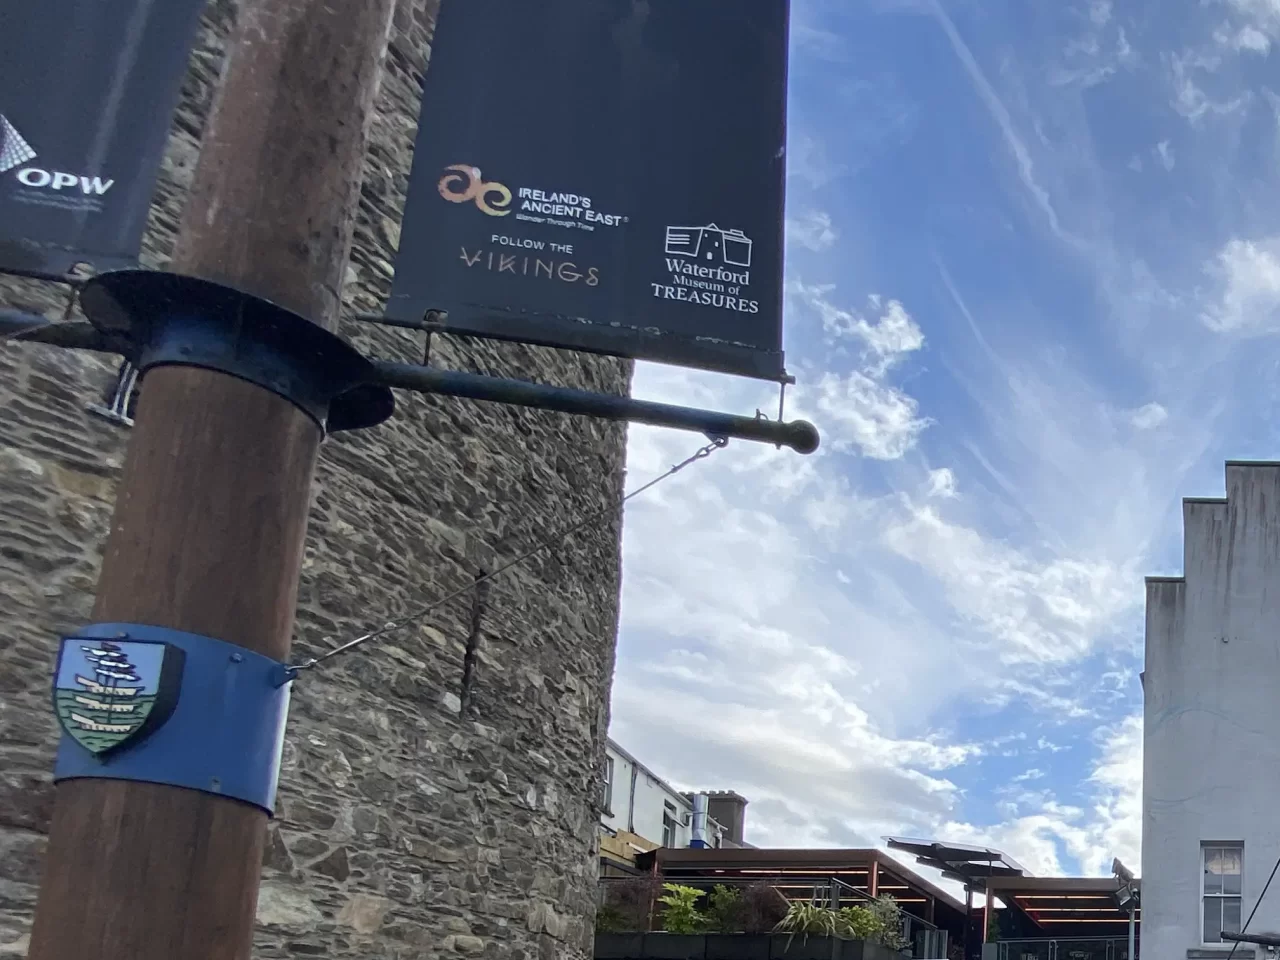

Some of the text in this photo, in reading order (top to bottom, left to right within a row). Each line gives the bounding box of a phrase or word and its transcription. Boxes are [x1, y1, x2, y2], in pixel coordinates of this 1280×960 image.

[16, 167, 115, 195] OPW
[518, 187, 592, 209] IRELAND'S
[521, 200, 584, 219] ANCIENT
[516, 213, 595, 232] Wander Through Time
[491, 234, 574, 255] FOLLOW THE
[460, 246, 599, 286] VIKINGS
[665, 258, 750, 286] Waterford
[672, 274, 741, 296] Museum of
[651, 282, 760, 314] TREASURES
